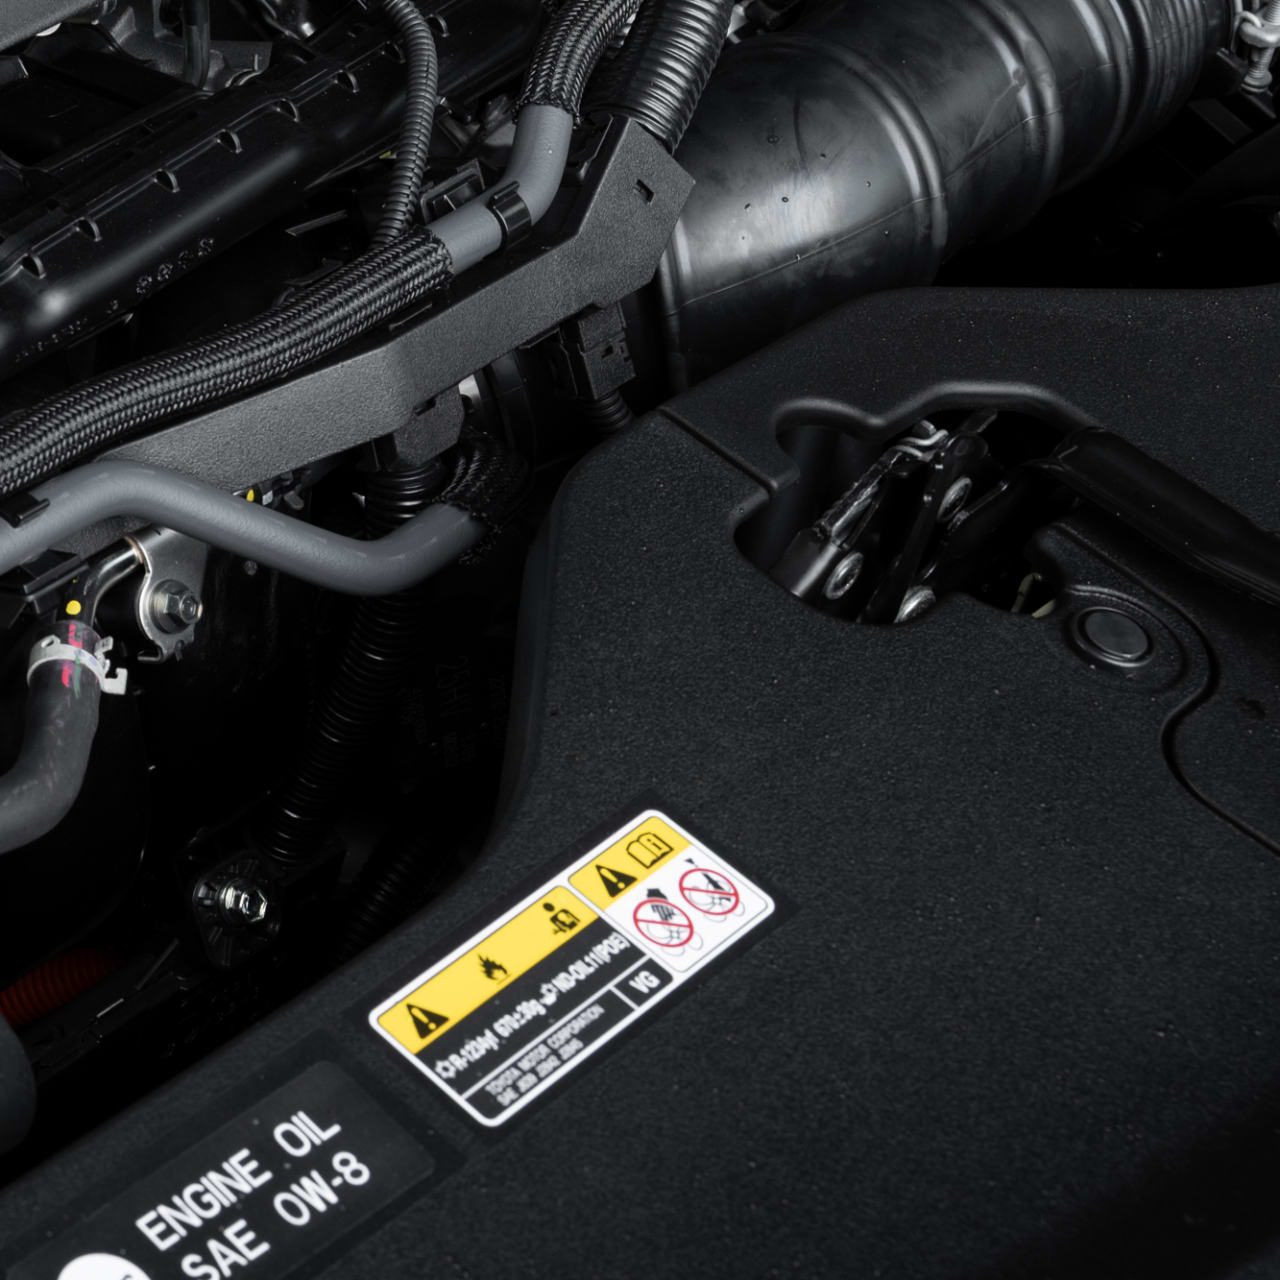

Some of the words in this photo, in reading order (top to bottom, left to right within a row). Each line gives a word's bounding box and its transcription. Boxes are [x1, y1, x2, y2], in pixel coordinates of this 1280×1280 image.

[628, 970, 661, 994] VG
[484, 1066, 522, 1095] TOYOTA
[517, 1043, 552, 1072] MOTOR
[546, 1003, 605, 1050] CORPORATION
[135, 1147, 273, 1252] ENGINE
[273, 1110, 342, 1157] OIL
[180, 1218, 271, 1280] SAE
